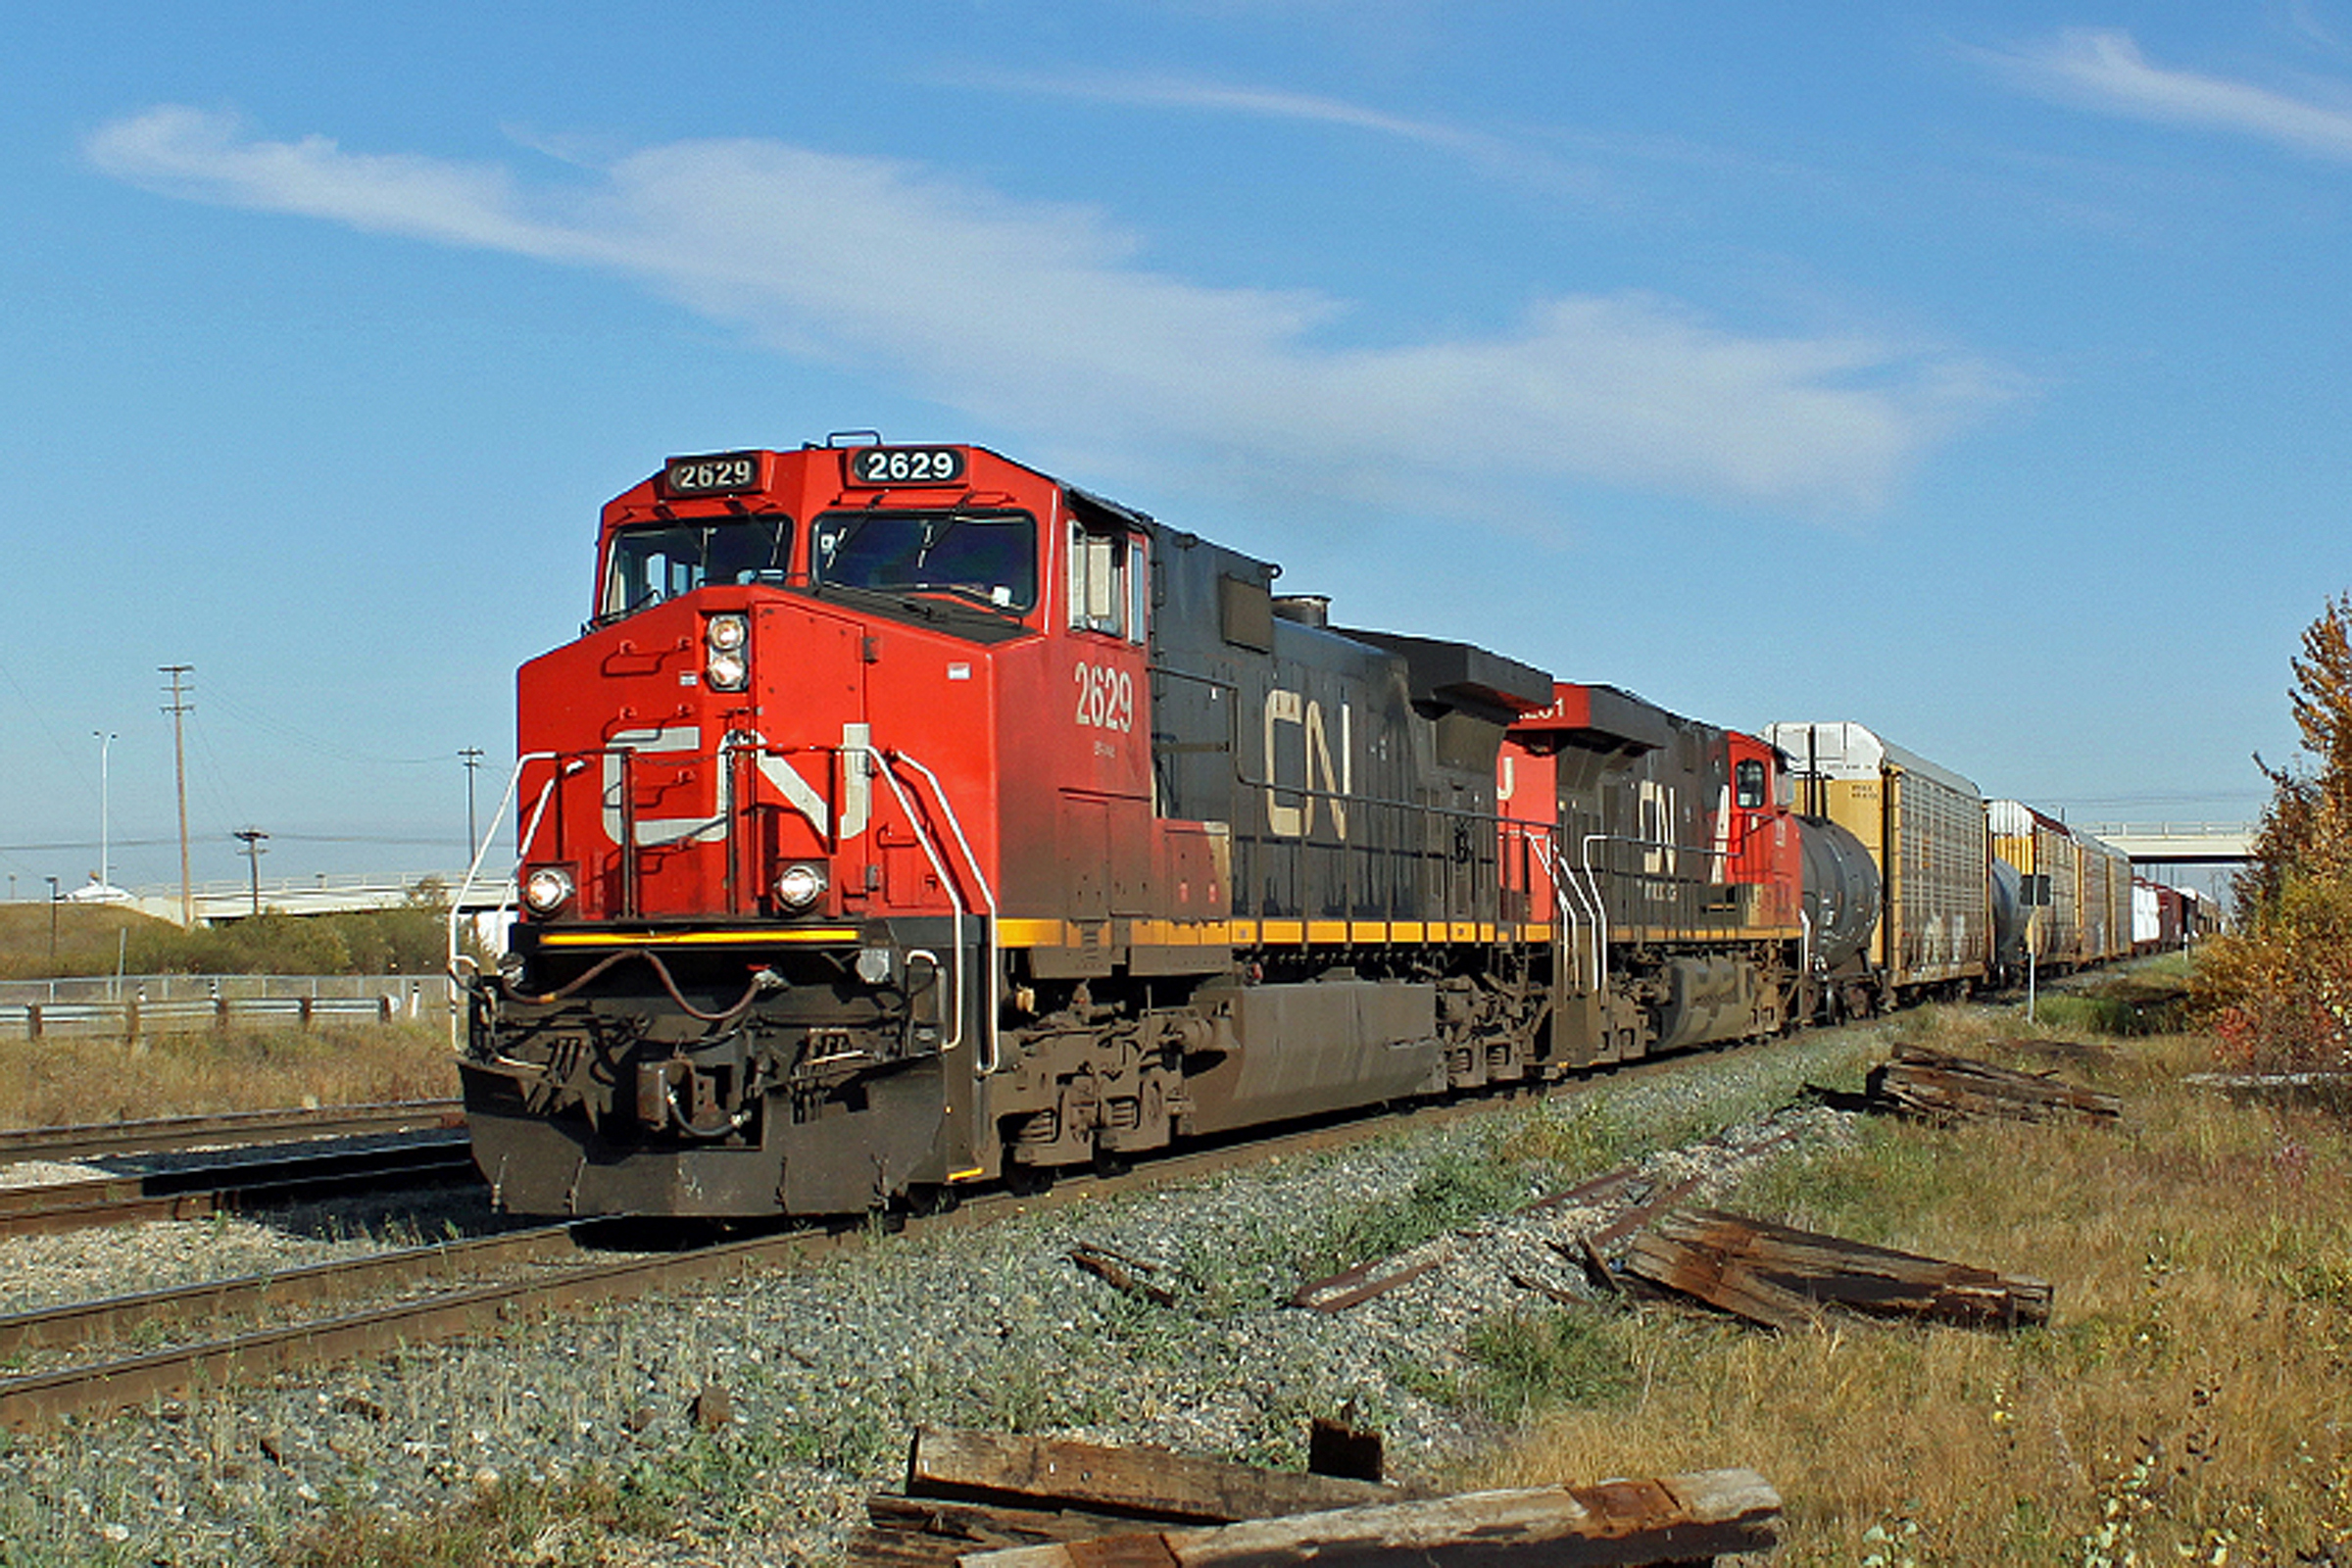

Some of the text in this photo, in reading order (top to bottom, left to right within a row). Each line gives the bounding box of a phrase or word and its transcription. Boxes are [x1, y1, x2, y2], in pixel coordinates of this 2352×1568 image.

[680, 460, 751, 488] 2629
[867, 452, 954, 480] 2629
[1075, 662, 1133, 733] 2629
[602, 722, 870, 847] CN
[1265, 689, 1350, 840] CN
